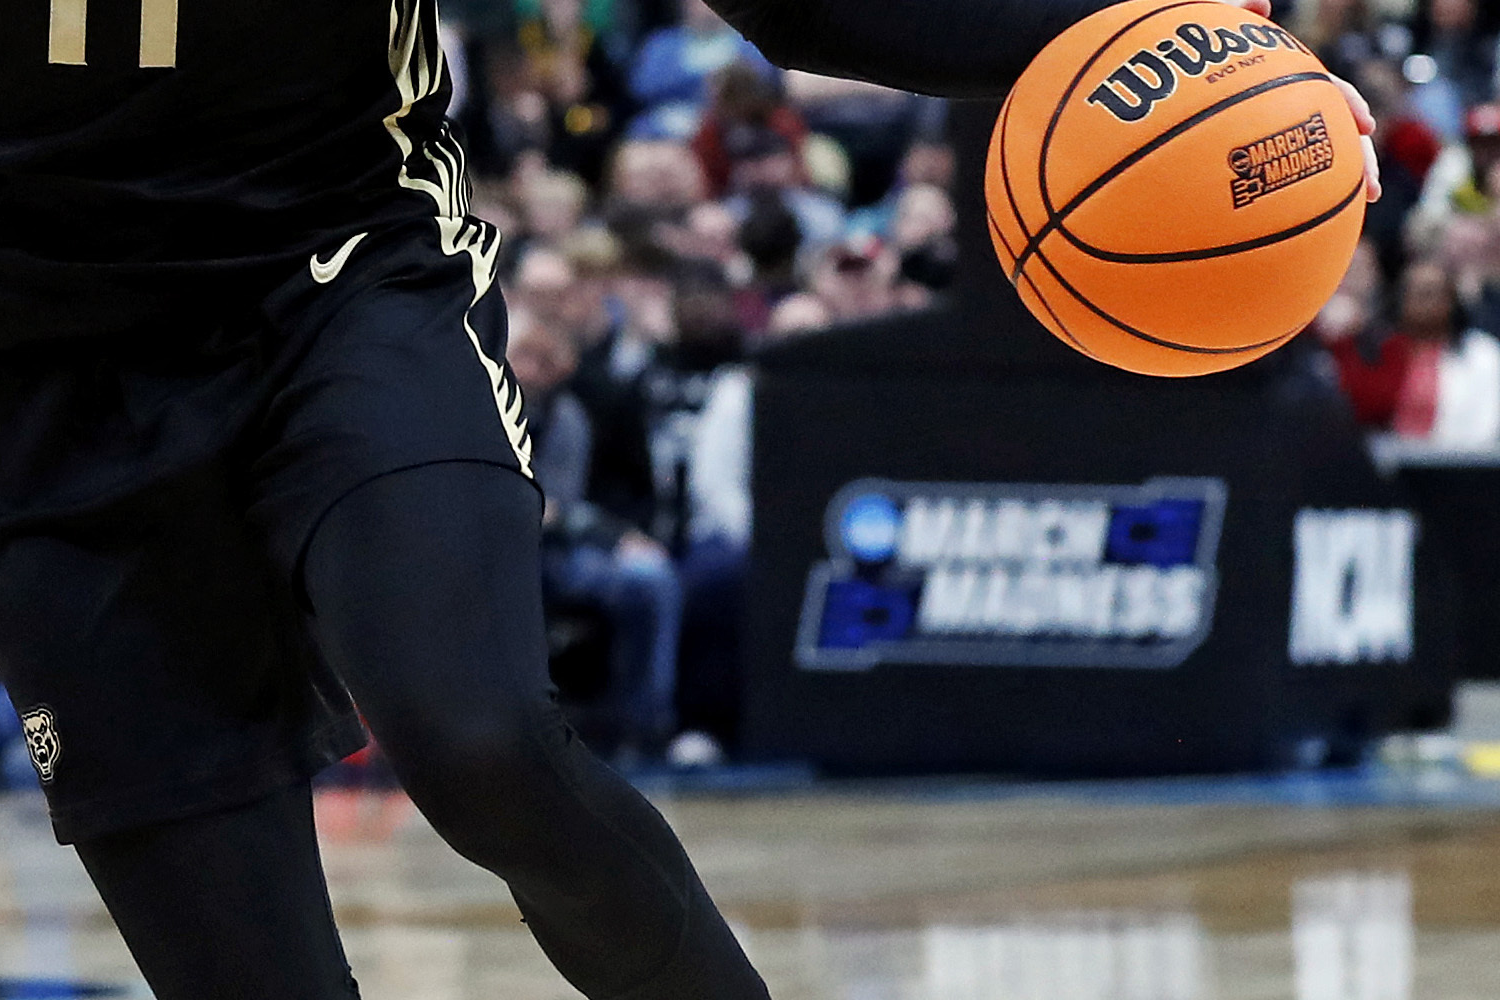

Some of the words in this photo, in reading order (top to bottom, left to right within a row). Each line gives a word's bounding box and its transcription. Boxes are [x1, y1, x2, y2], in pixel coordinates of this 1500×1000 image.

[1085, 22, 1312, 123] Wilson
[1206, 64, 1236, 84] EVO
[1238, 55, 1265, 67] NXT
[1248, 126, 1307, 166] MARCH
[1264, 138, 1333, 184] MADNESS
[902, 498, 1108, 564] MARCH
[918, 565, 1206, 637] MADNESS
